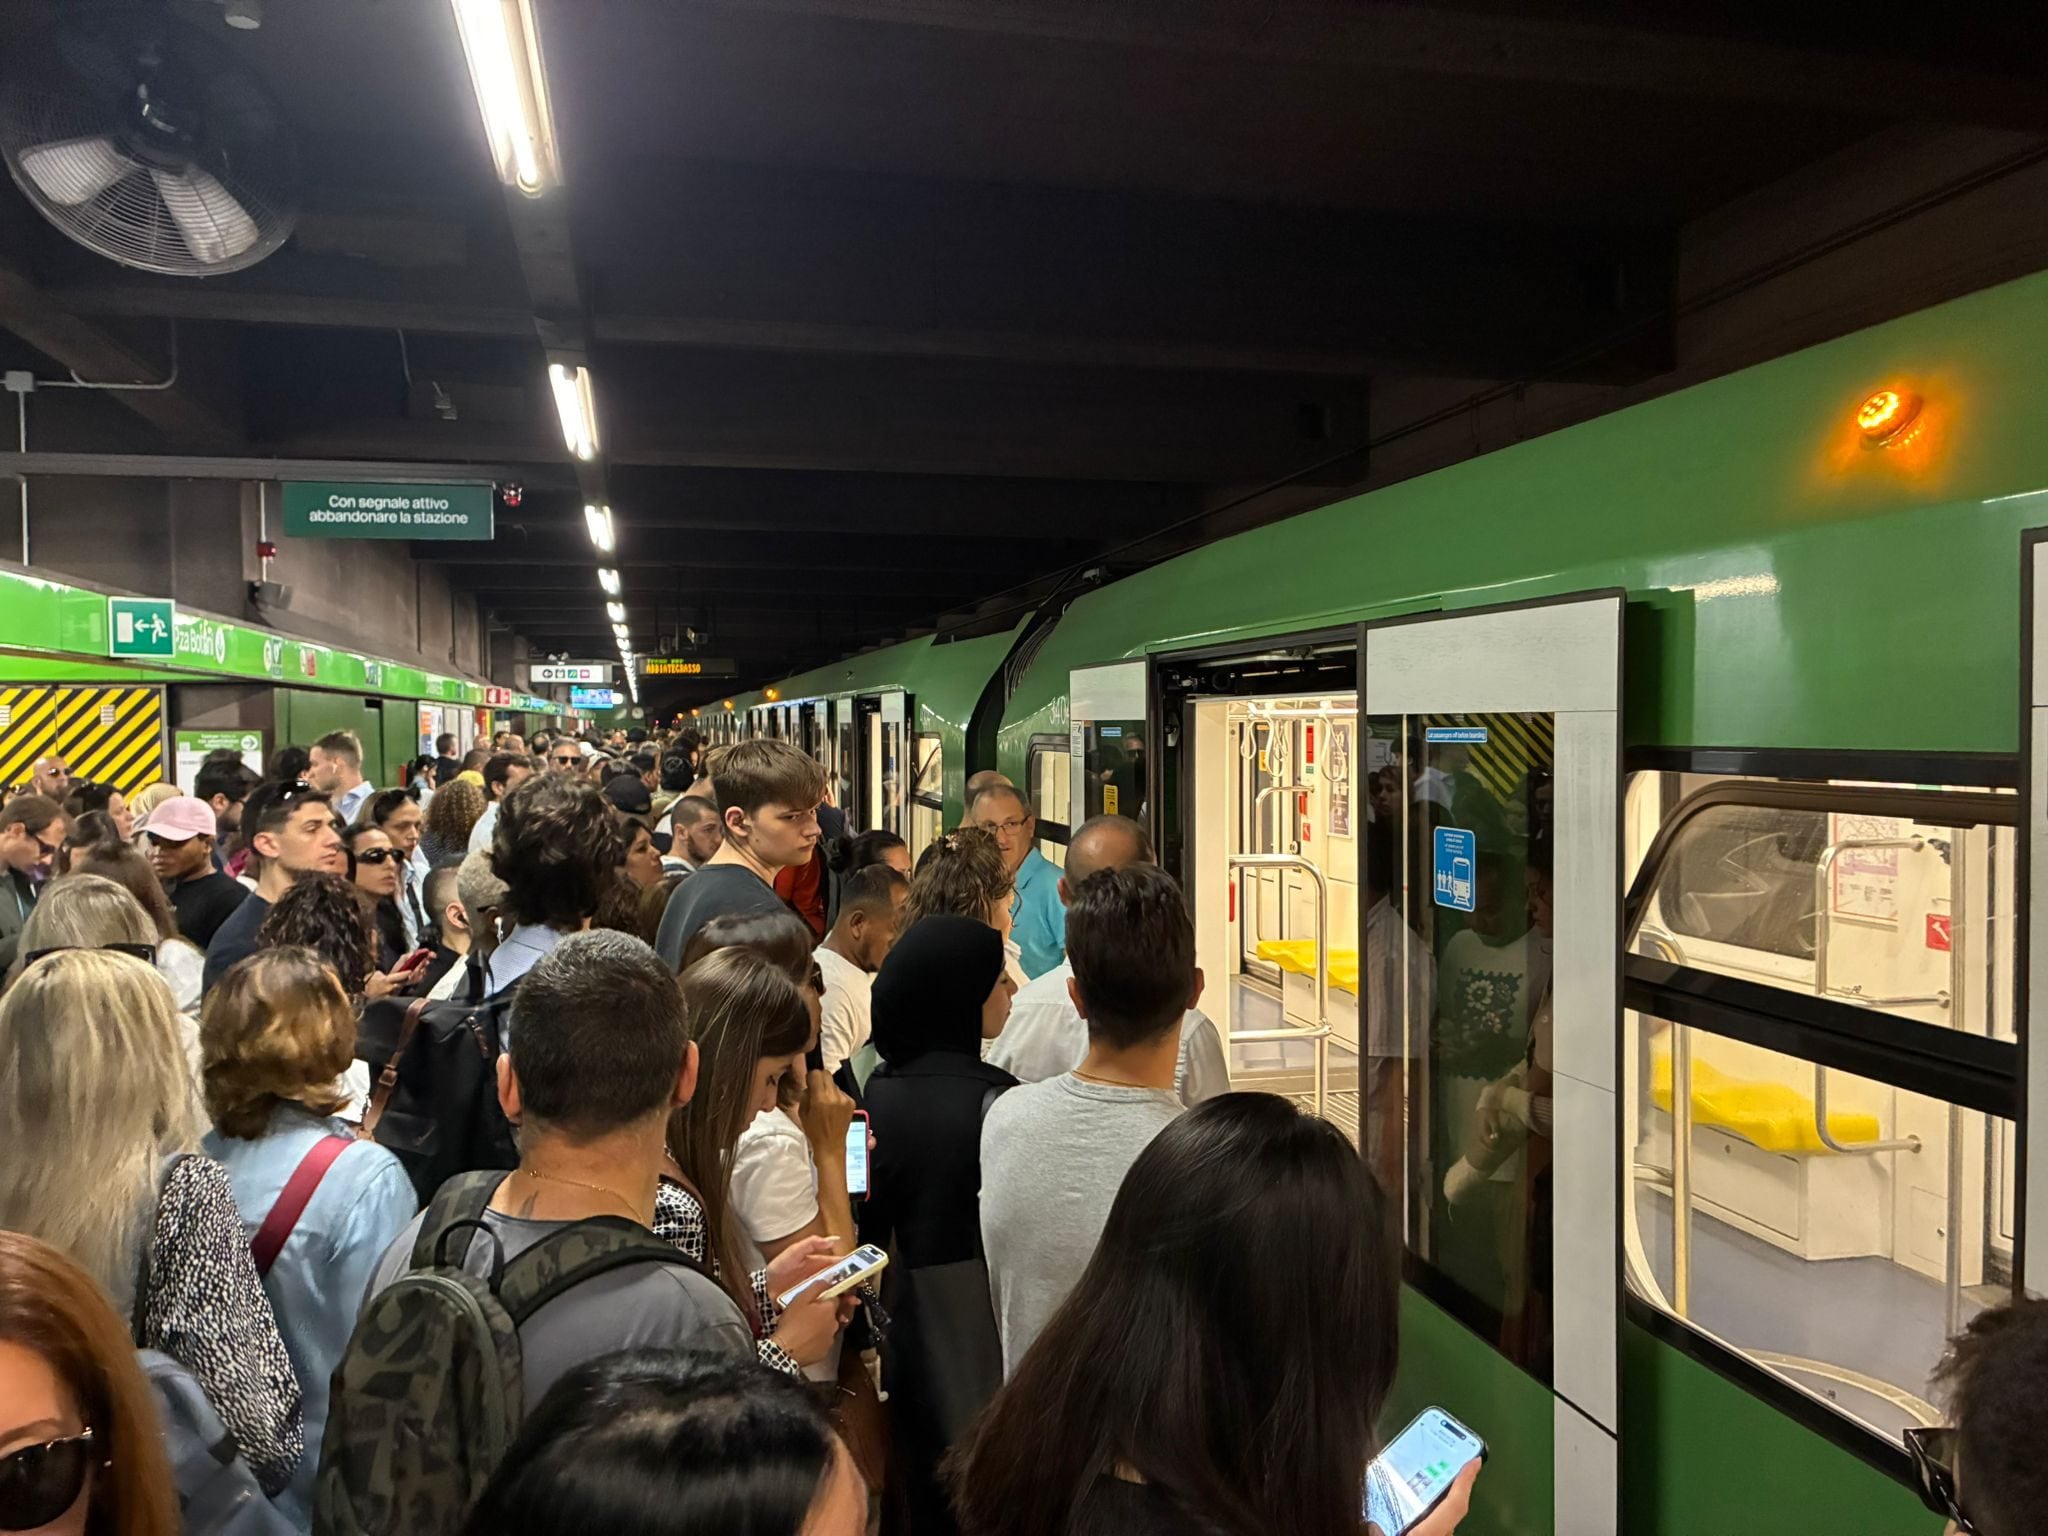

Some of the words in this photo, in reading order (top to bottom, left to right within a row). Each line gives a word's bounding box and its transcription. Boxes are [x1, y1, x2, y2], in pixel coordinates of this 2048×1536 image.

[329, 495, 356, 509] Con
[358, 496, 410, 511] segnale
[412, 497, 448, 510] attivo
[309, 509, 397, 523] abbandonare
[400, 511, 411, 523] la
[413, 511, 468, 524] stazione
